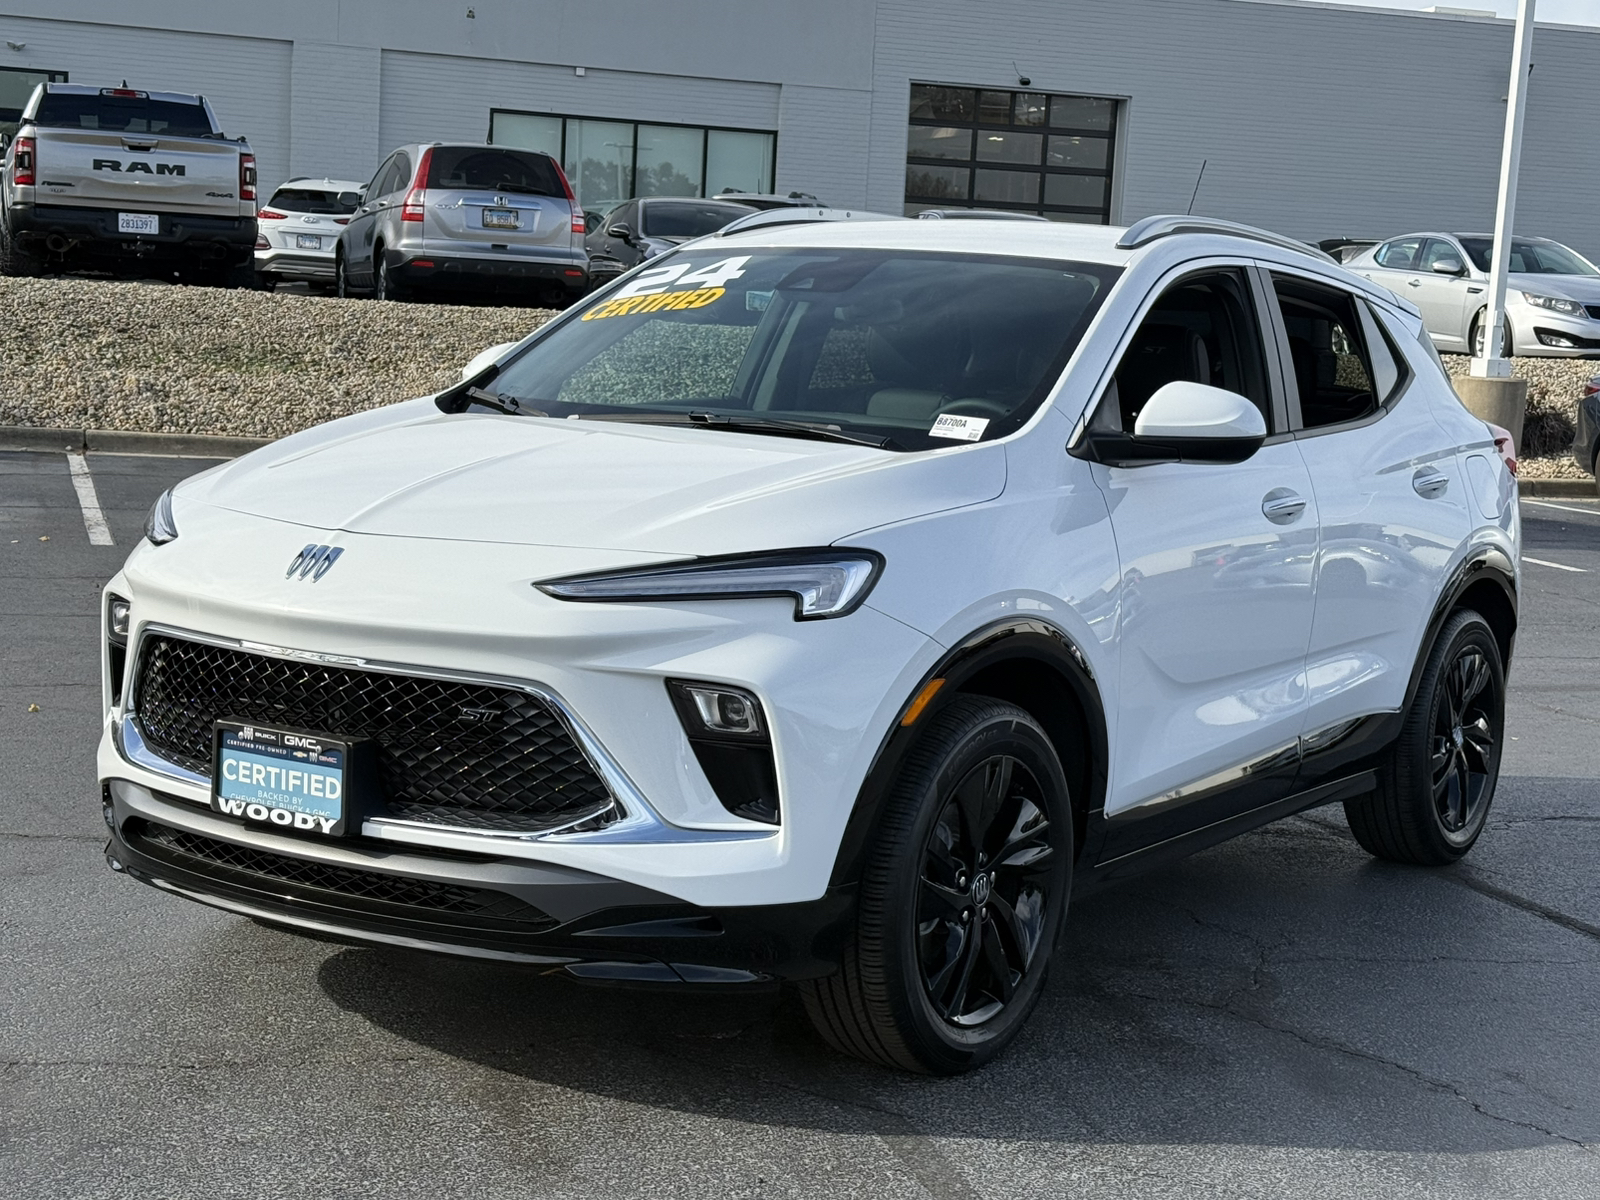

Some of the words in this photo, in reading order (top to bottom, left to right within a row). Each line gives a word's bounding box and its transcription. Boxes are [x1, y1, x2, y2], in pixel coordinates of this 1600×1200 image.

[93, 158, 186, 176] RAM
[610, 255, 752, 301] 24
[581, 287, 726, 322] CERTIFIED
[936, 417, 968, 428] B8700A
[458, 707, 501, 722] ST
[226, 739, 254, 749] CERTIFIED
[318, 755, 338, 764] GMC
[254, 731, 277, 740] BUICK
[284, 735, 317, 750] GMC
[222, 758, 341, 800] CERTIFIED
[257, 790, 290, 803] BACKED
[292, 796, 303, 805] BY
[217, 797, 338, 834] WOODY
